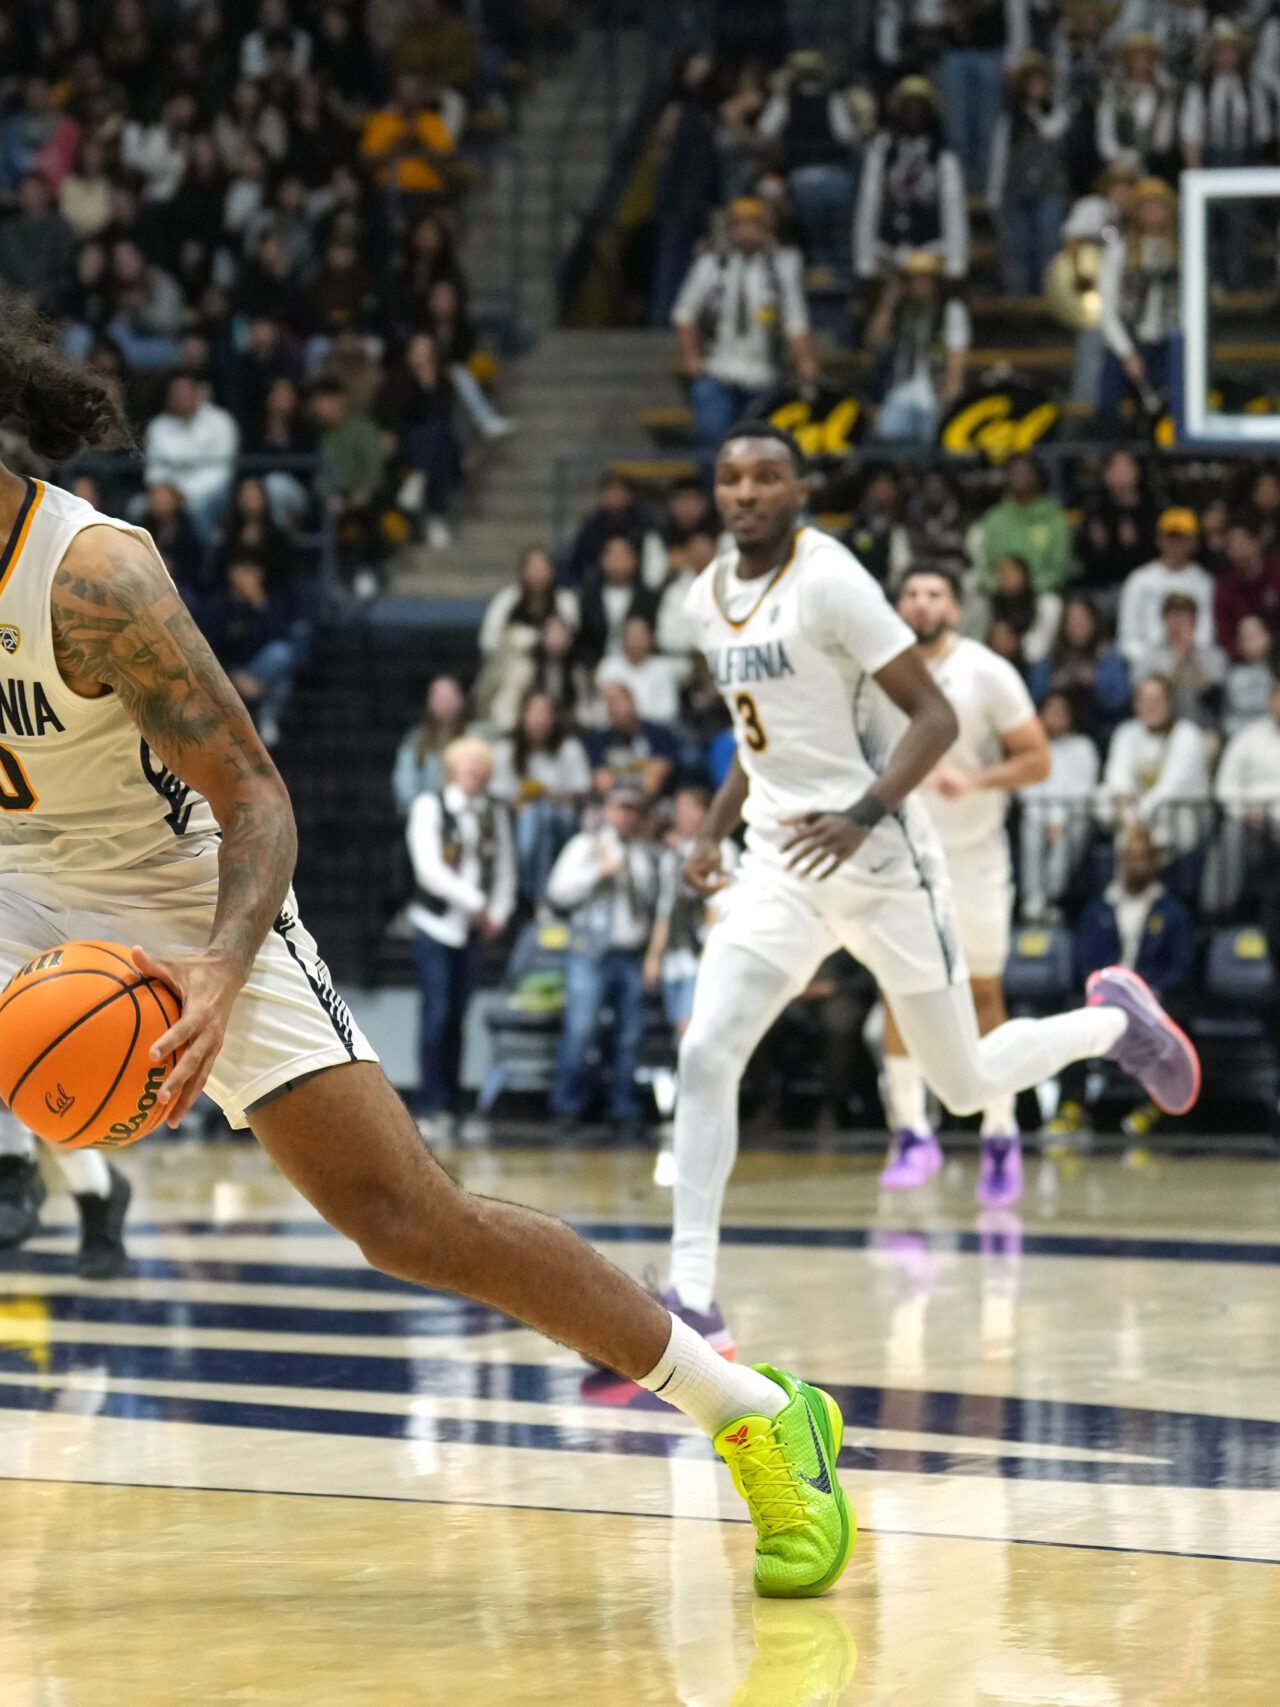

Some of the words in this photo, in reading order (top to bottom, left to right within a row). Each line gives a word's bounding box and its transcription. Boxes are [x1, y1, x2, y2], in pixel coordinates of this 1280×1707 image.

[943, 395, 1058, 464] Cal
[734, 690, 768, 754] 3
[44, 1082, 75, 1118] Cal
[95, 1064, 167, 1146] ilson
